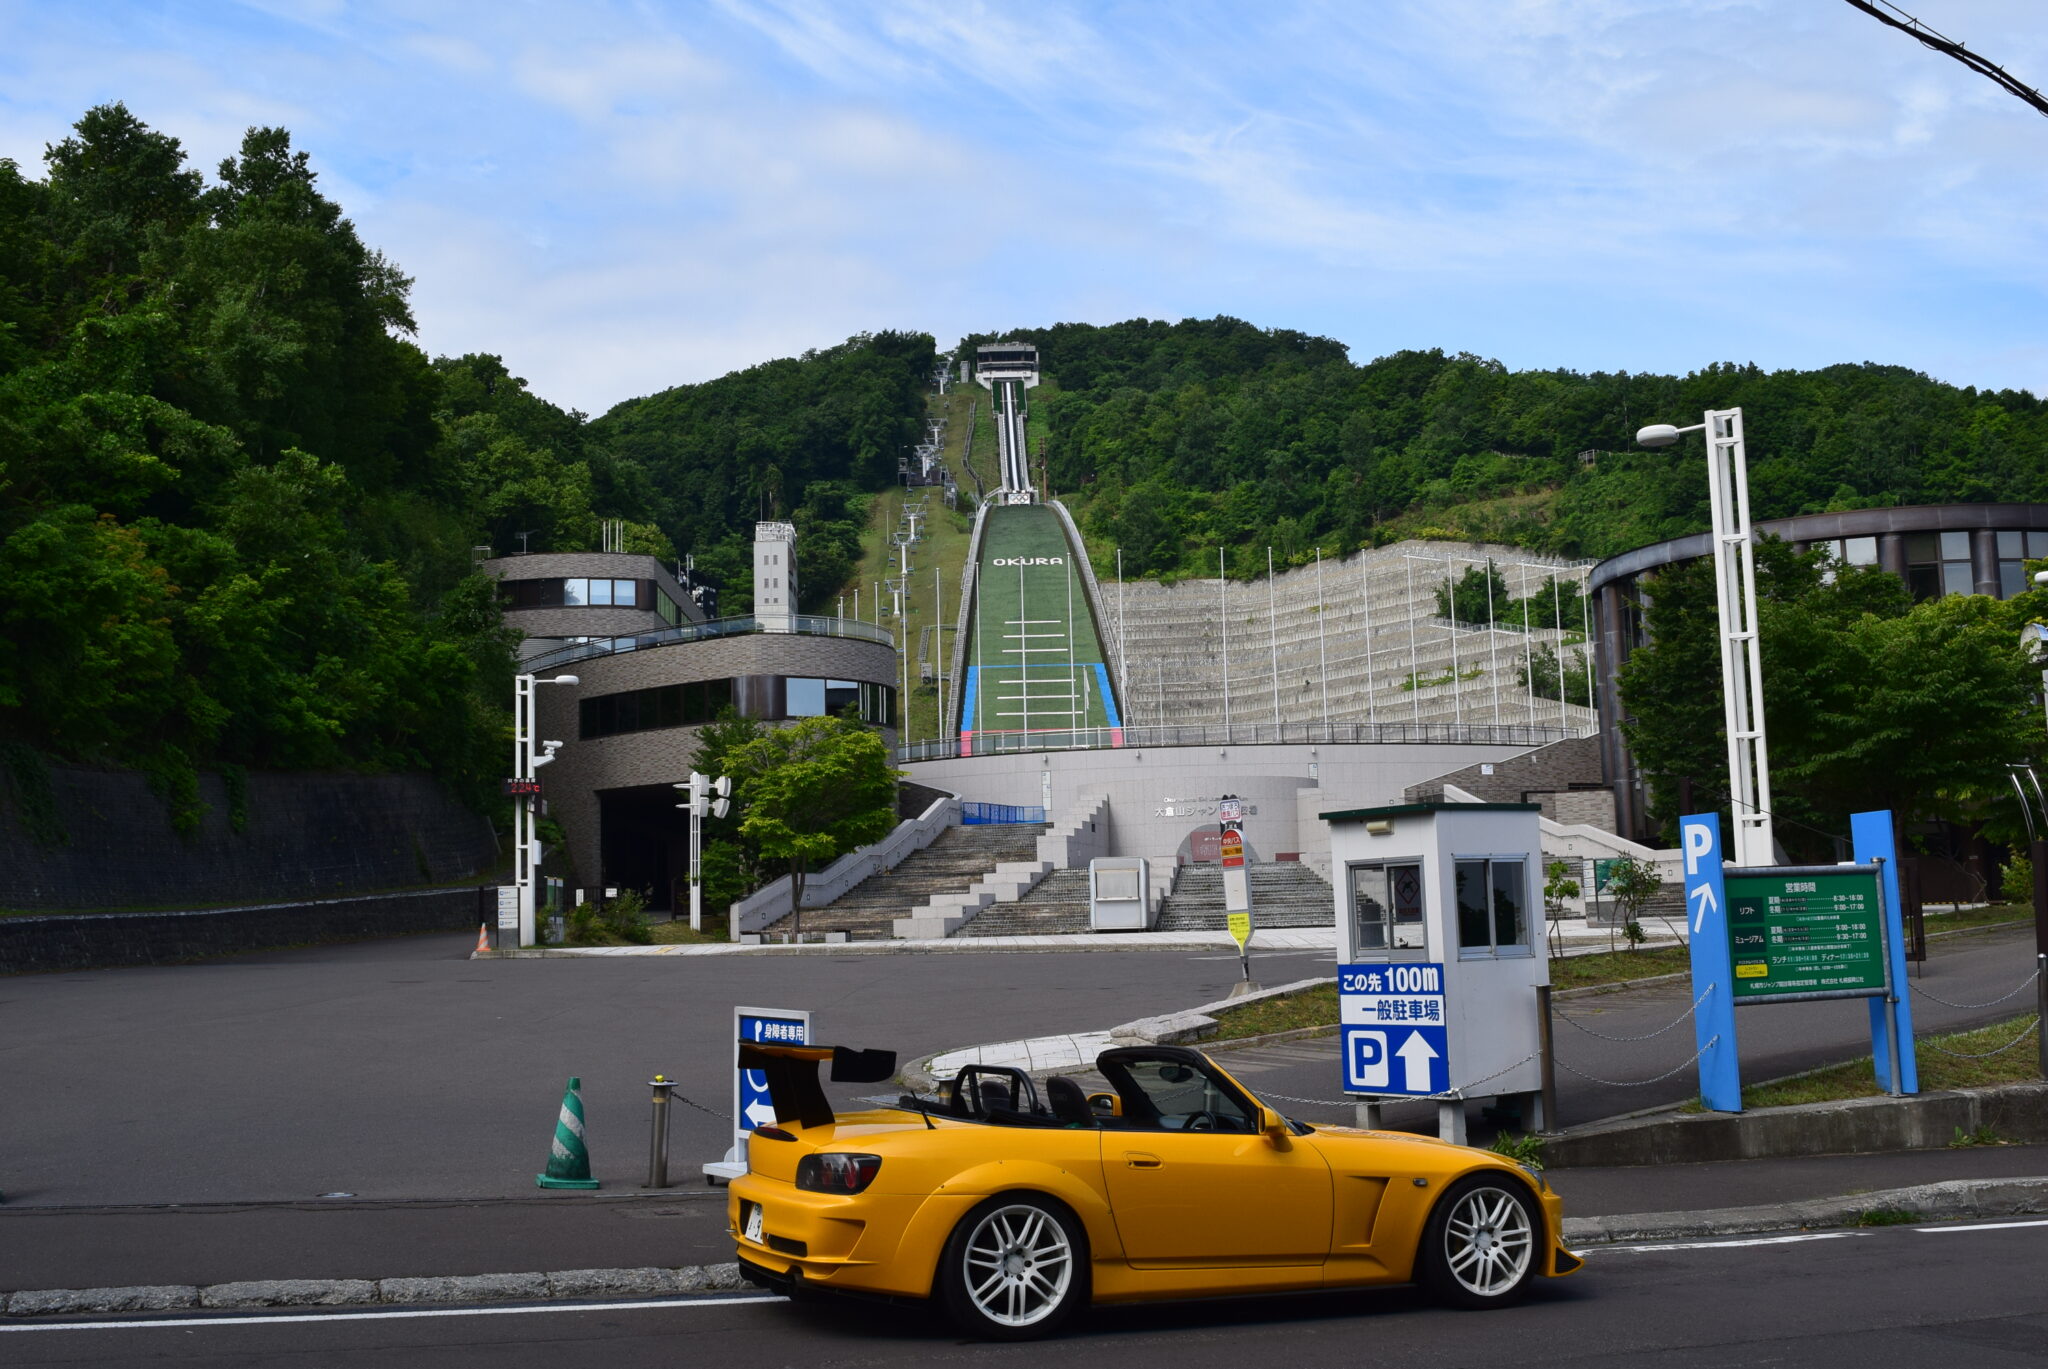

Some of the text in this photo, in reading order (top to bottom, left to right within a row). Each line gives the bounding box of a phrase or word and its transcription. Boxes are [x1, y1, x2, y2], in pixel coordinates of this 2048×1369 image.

[993, 557, 1063, 567] OKURA
[1684, 824, 1713, 875] P
[1785, 881, 1816, 893] 営業時間
[1739, 907, 1755, 915] リフト
[1735, 935, 1765, 944] ミュージアム
[1343, 967, 1439, 993] この先 100m
[1362, 999, 1440, 1022] 一般駐車場
[764, 1023, 804, 1041] 身障者専用
[1354, 1037, 1383, 1079] P
